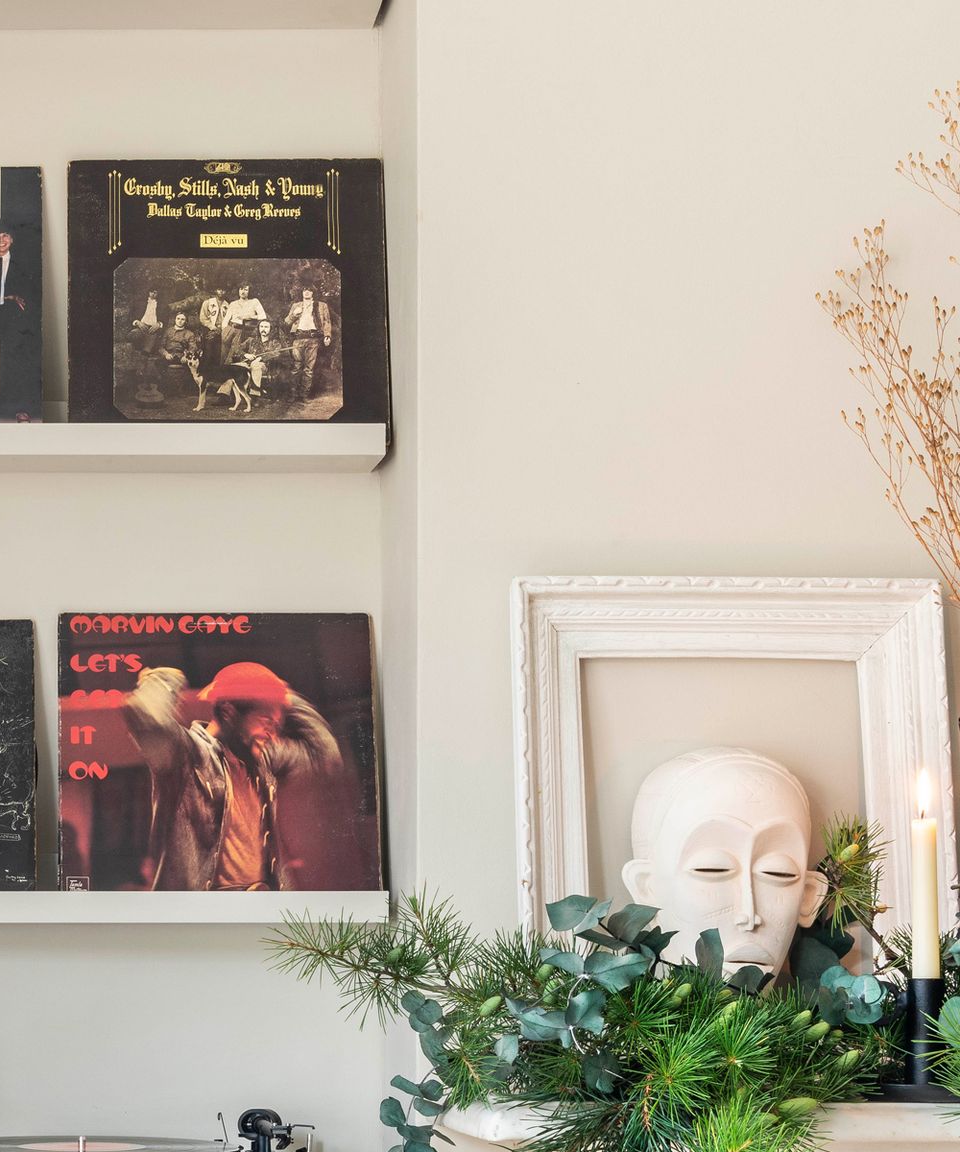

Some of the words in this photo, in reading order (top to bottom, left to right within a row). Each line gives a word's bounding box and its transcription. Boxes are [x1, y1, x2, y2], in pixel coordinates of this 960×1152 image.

[123, 177, 176, 201] Crosby,
[222, 177, 260, 200] Nash
[265, 179, 276, 196] &
[276, 177, 326, 200] Young
[146, 202, 183, 219] Dallas
[184, 202, 222, 221] Taylor
[224, 204, 232, 218] &
[233, 203, 262, 220] Greg
[262, 203, 302, 219] Reeves
[204, 235, 227, 247] Déjà
[230, 236, 244, 245] vu
[69, 615, 174, 634] MARVIN
[178, 615, 253, 634] GAYE
[70, 653, 143, 673] LET'S
[70, 725, 97, 744] IT
[68, 760, 109, 780] ON
